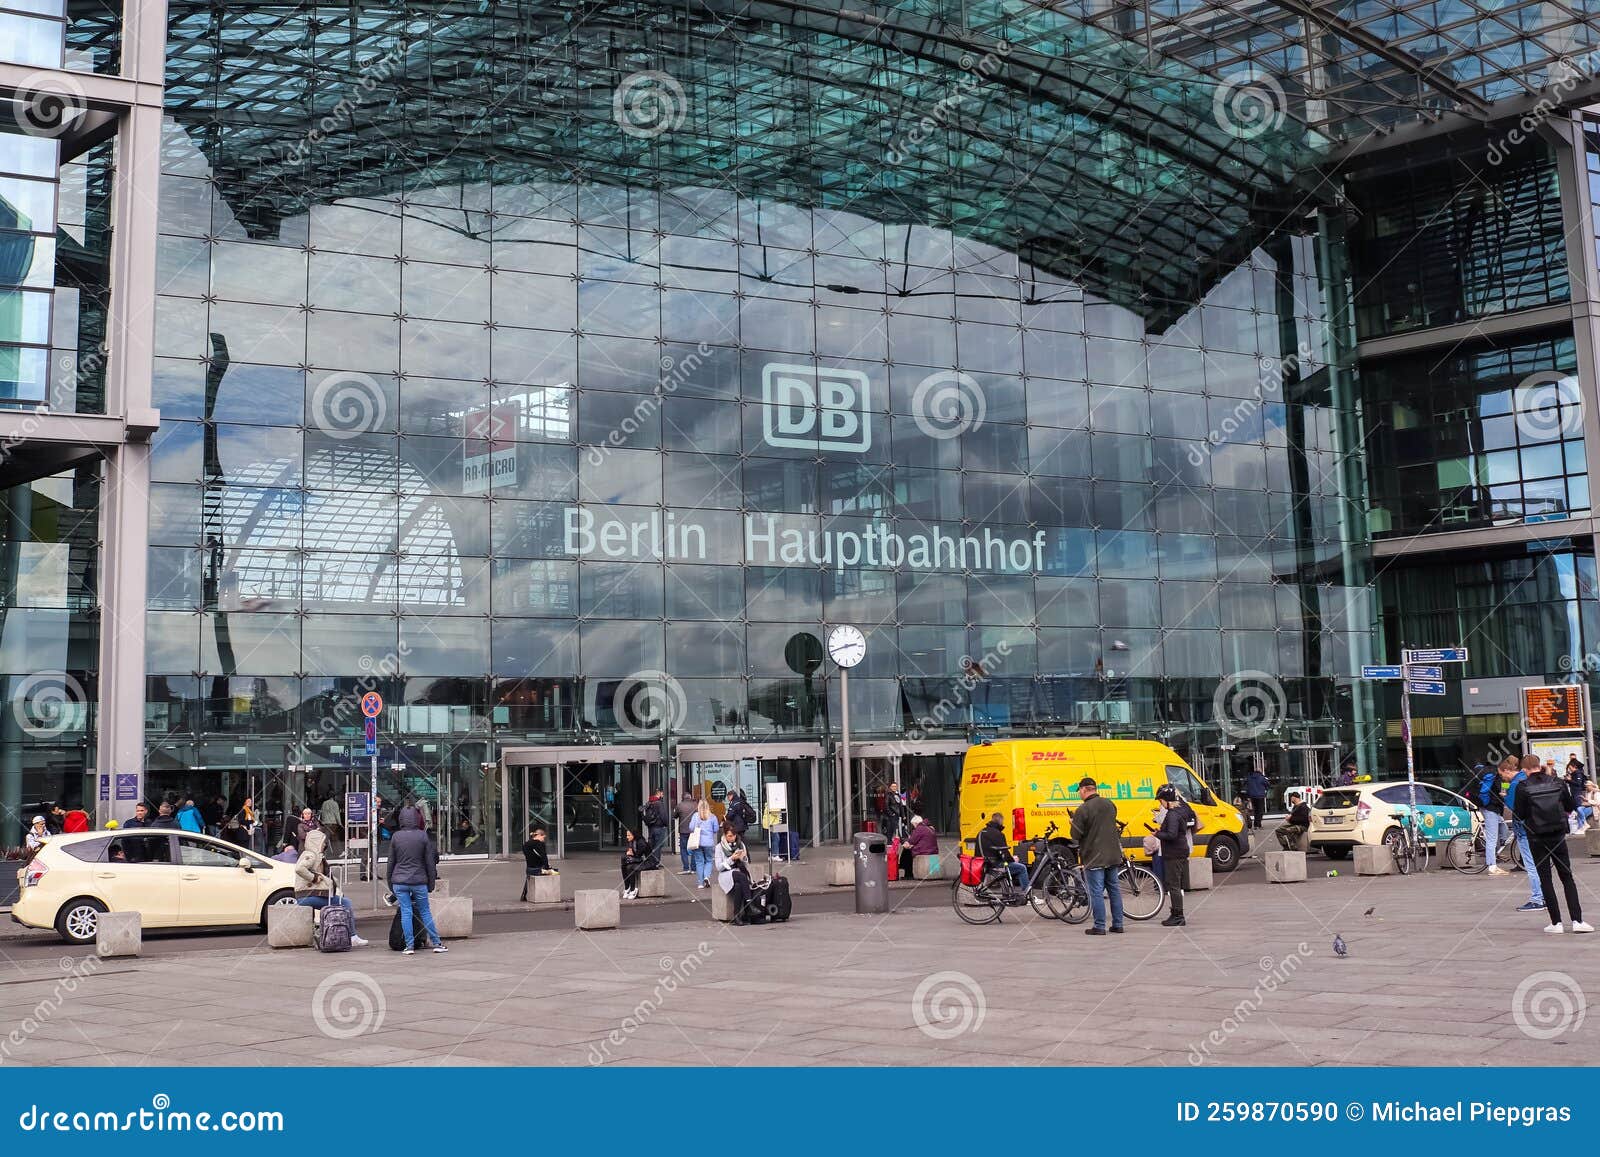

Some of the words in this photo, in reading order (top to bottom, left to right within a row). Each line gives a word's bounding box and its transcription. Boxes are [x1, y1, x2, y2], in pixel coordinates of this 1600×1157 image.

[775, 375, 860, 439] DB
[563, 507, 706, 560] Berlin
[745, 515, 1046, 574] Hauptbahnhof
[1031, 751, 1068, 761] DHL
[970, 772, 999, 785] DHL
